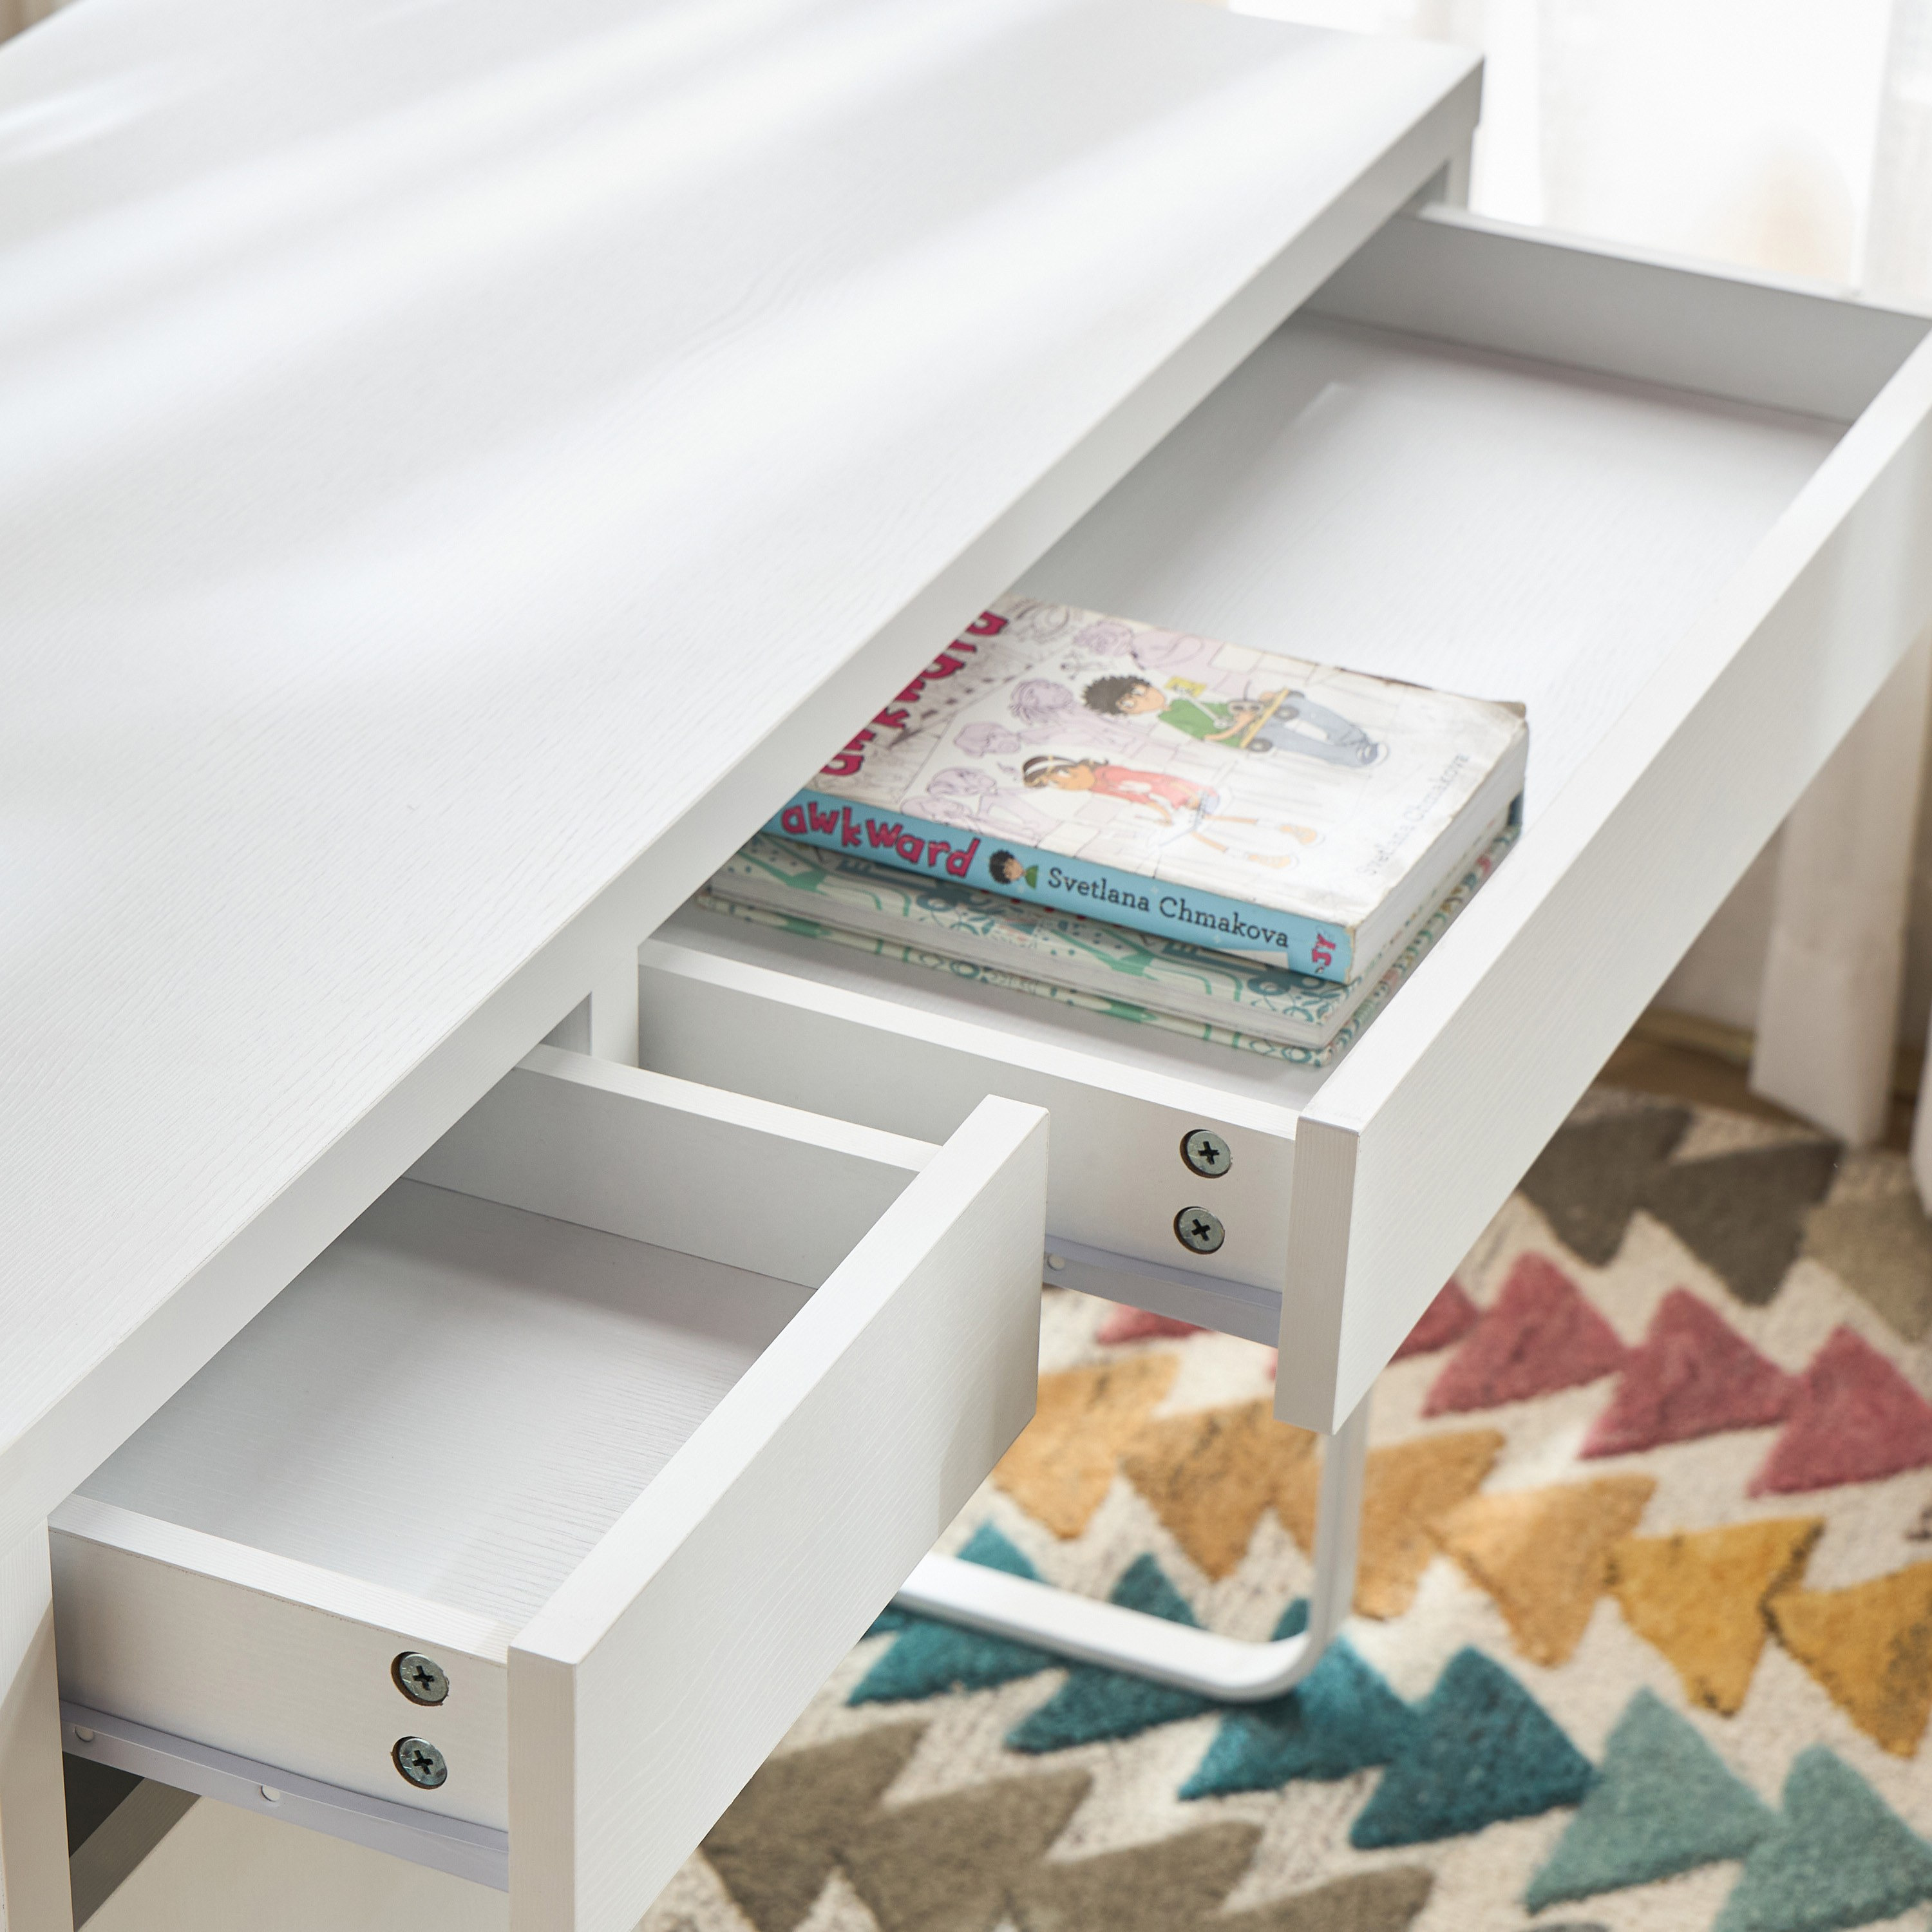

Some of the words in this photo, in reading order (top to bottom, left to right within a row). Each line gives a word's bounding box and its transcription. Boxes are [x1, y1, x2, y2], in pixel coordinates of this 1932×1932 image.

[781, 801, 981, 878] awkward
[1048, 867, 1151, 912] Svetlana
[1159, 896, 1288, 948] Chmakova
[1312, 933, 1336, 967] JY
